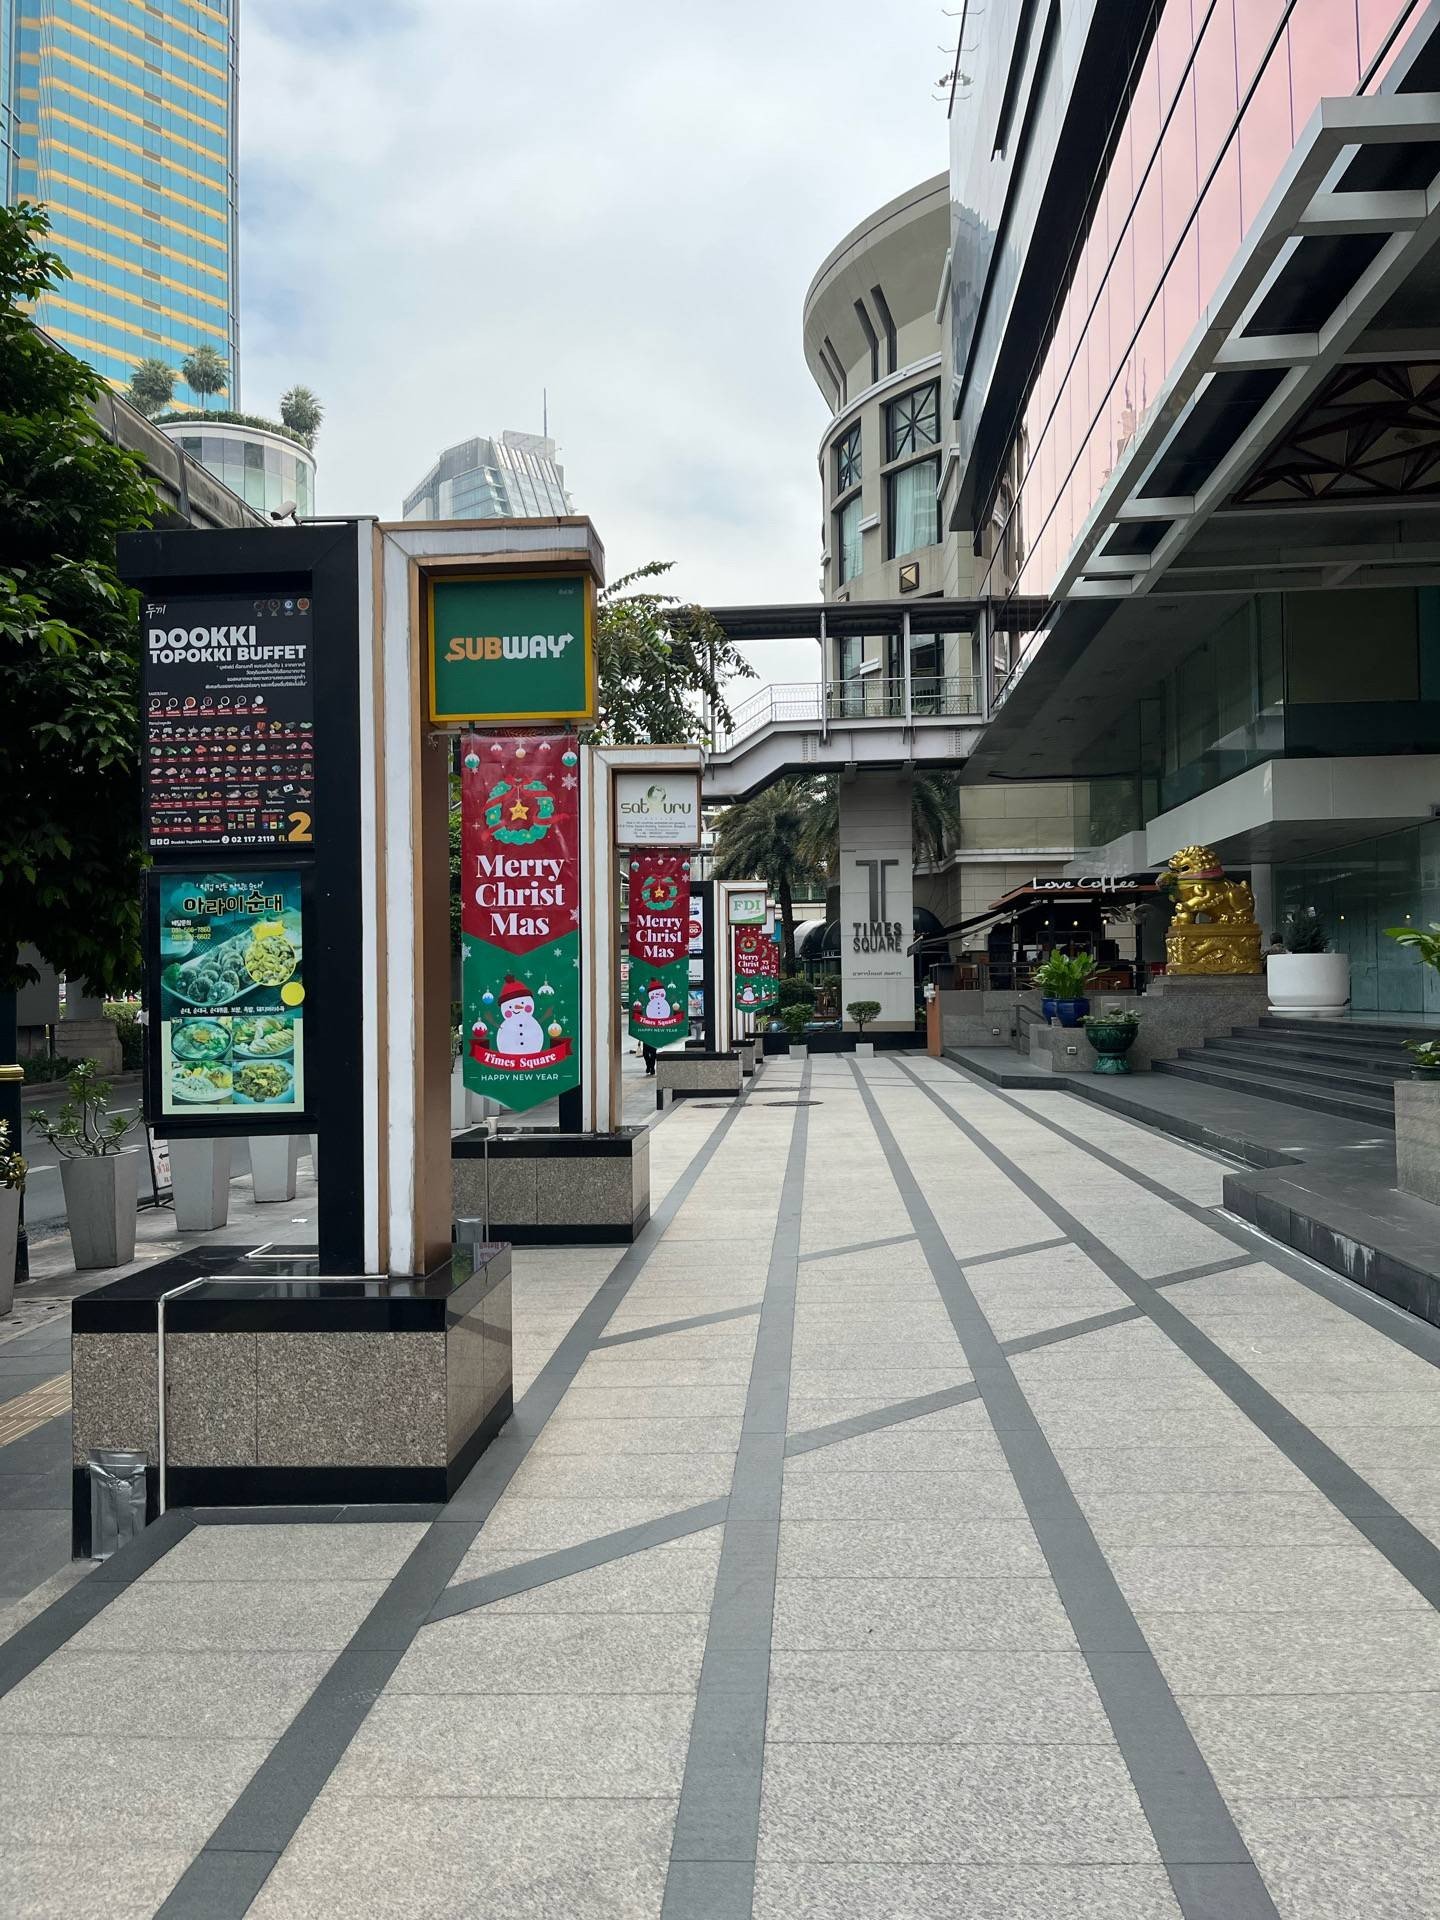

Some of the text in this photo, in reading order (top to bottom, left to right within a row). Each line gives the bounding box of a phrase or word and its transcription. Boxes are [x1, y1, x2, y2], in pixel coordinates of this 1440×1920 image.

[149, 625, 257, 649] DOOKKI
[149, 645, 307, 664] TOPOKKI BUFFET
[444, 632, 575, 663] SUBWAY
[287, 811, 313, 842] 2
[231, 835, 275, 843] 02 117 2119
[476, 854, 565, 881] Merry
[1033, 876, 1139, 893] Love Coffee
[475, 881, 566, 907] Christ
[734, 900, 761, 911] FDI
[489, 912, 550, 936] Mas
[636, 914, 684, 930] Merry
[853, 922, 902, 937] TIMES
[636, 929, 682, 943] Christ
[643, 945, 675, 958] Mas
[853, 937, 902, 953] SQUARE
[737, 960, 760, 968] Christ
[738, 954, 759, 962] Merry
[658, 1017, 677, 1026] Square
[484, 1052, 557, 1068] Times Square
